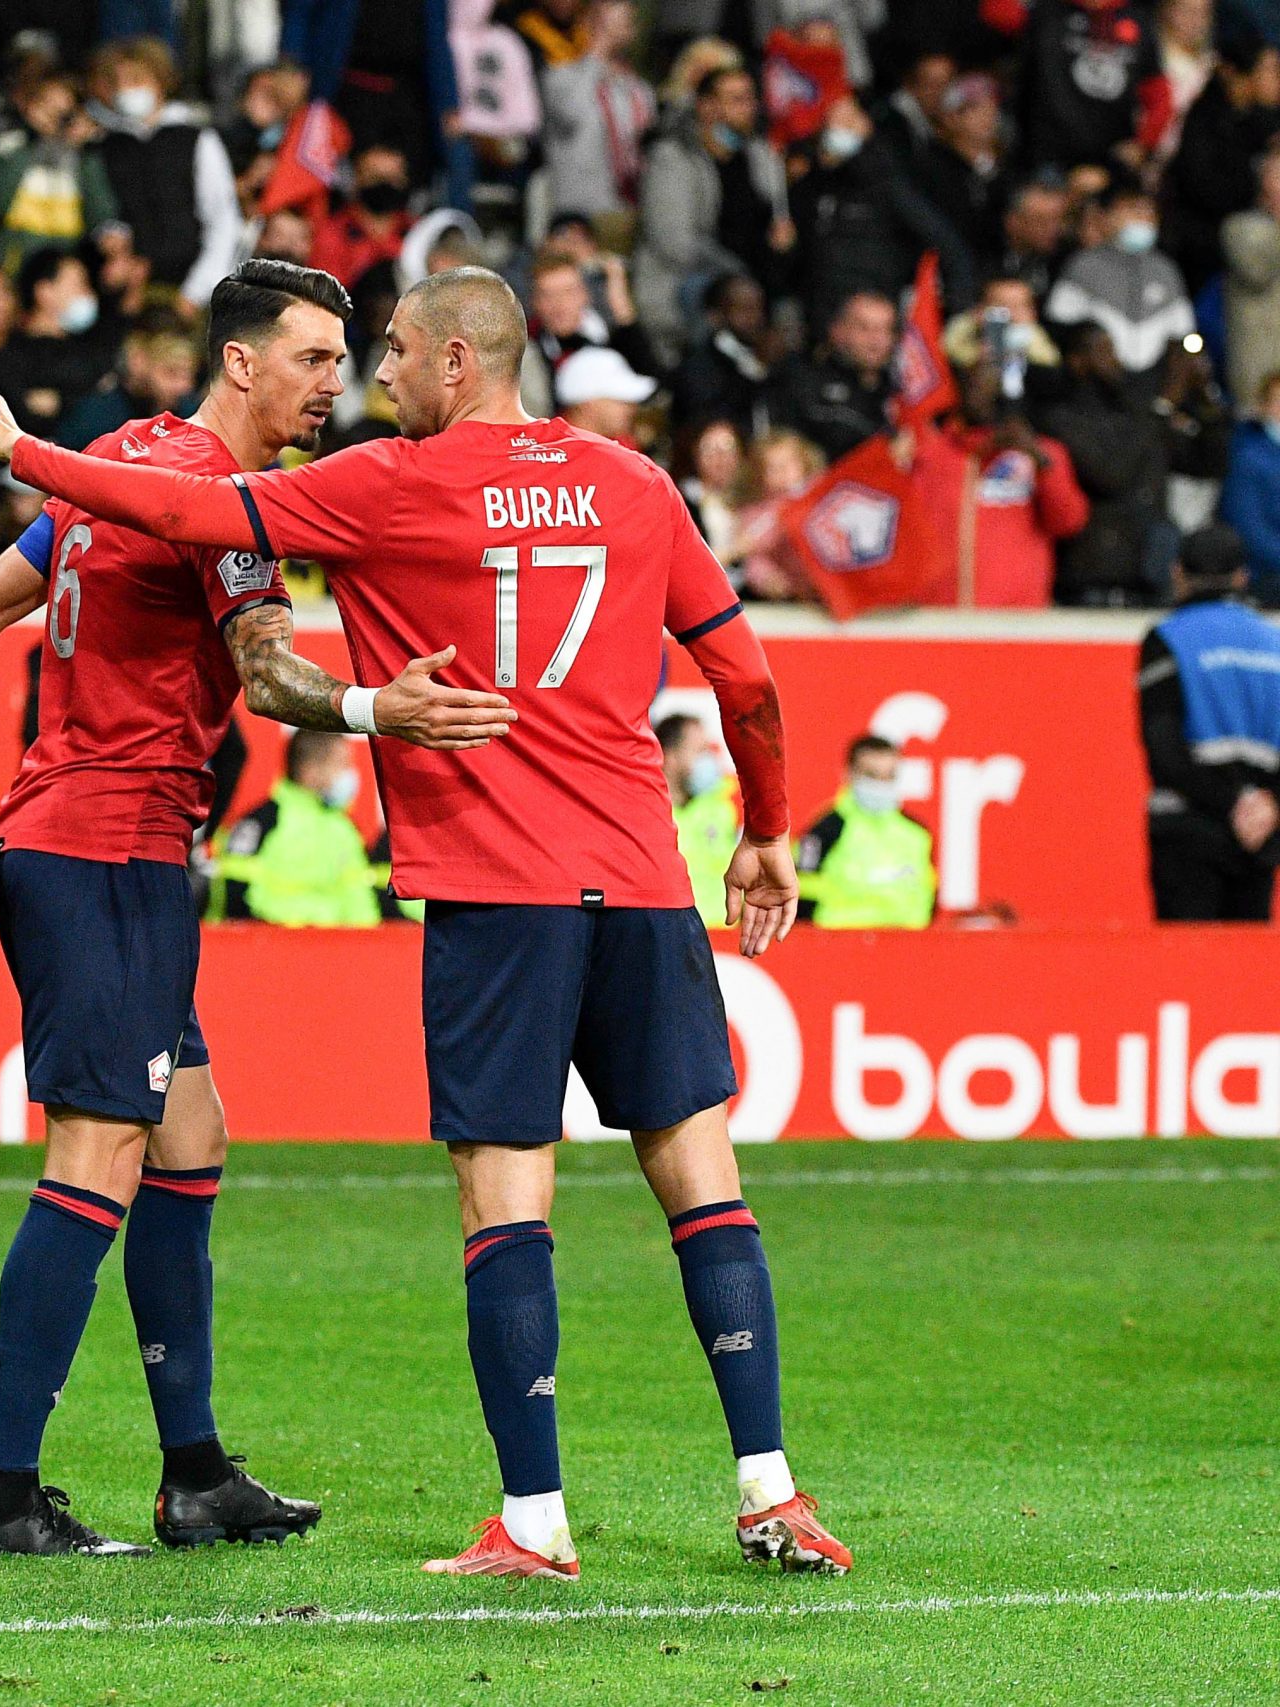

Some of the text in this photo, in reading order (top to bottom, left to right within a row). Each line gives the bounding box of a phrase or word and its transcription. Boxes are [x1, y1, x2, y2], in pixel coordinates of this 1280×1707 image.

[483, 485, 602, 529] BURAK
[50, 524, 93, 660] 6
[480, 545, 608, 689] 17
